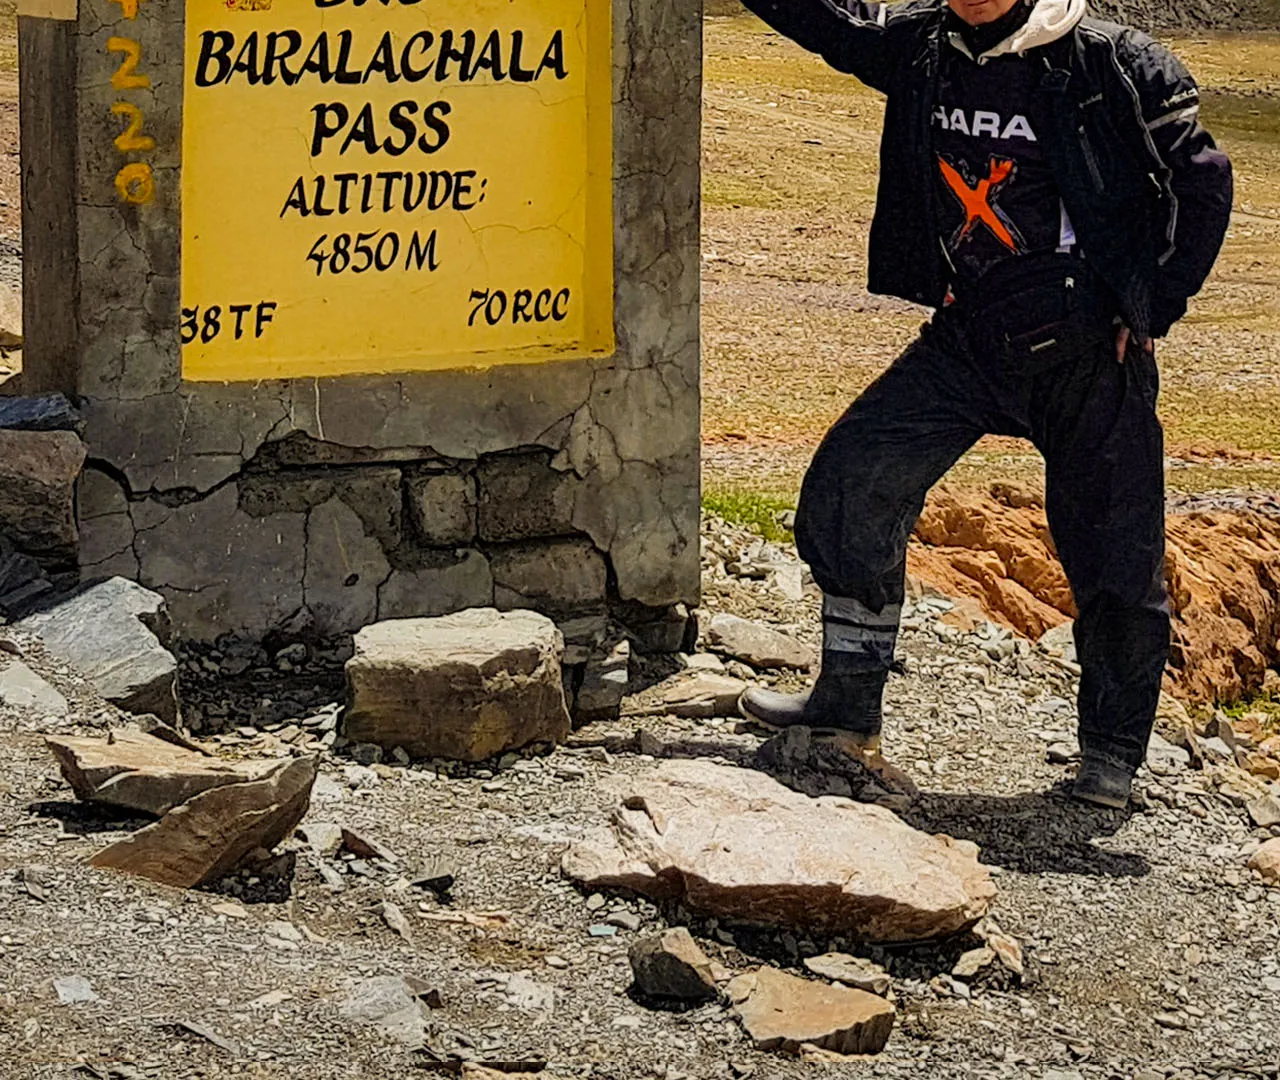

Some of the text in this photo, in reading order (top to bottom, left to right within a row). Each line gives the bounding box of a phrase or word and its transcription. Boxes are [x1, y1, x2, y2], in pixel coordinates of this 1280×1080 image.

[194, 29, 569, 88] BARALACHALA
[310, 100, 452, 157] PASS
[279, 170, 487, 218] ALTITUDE:
